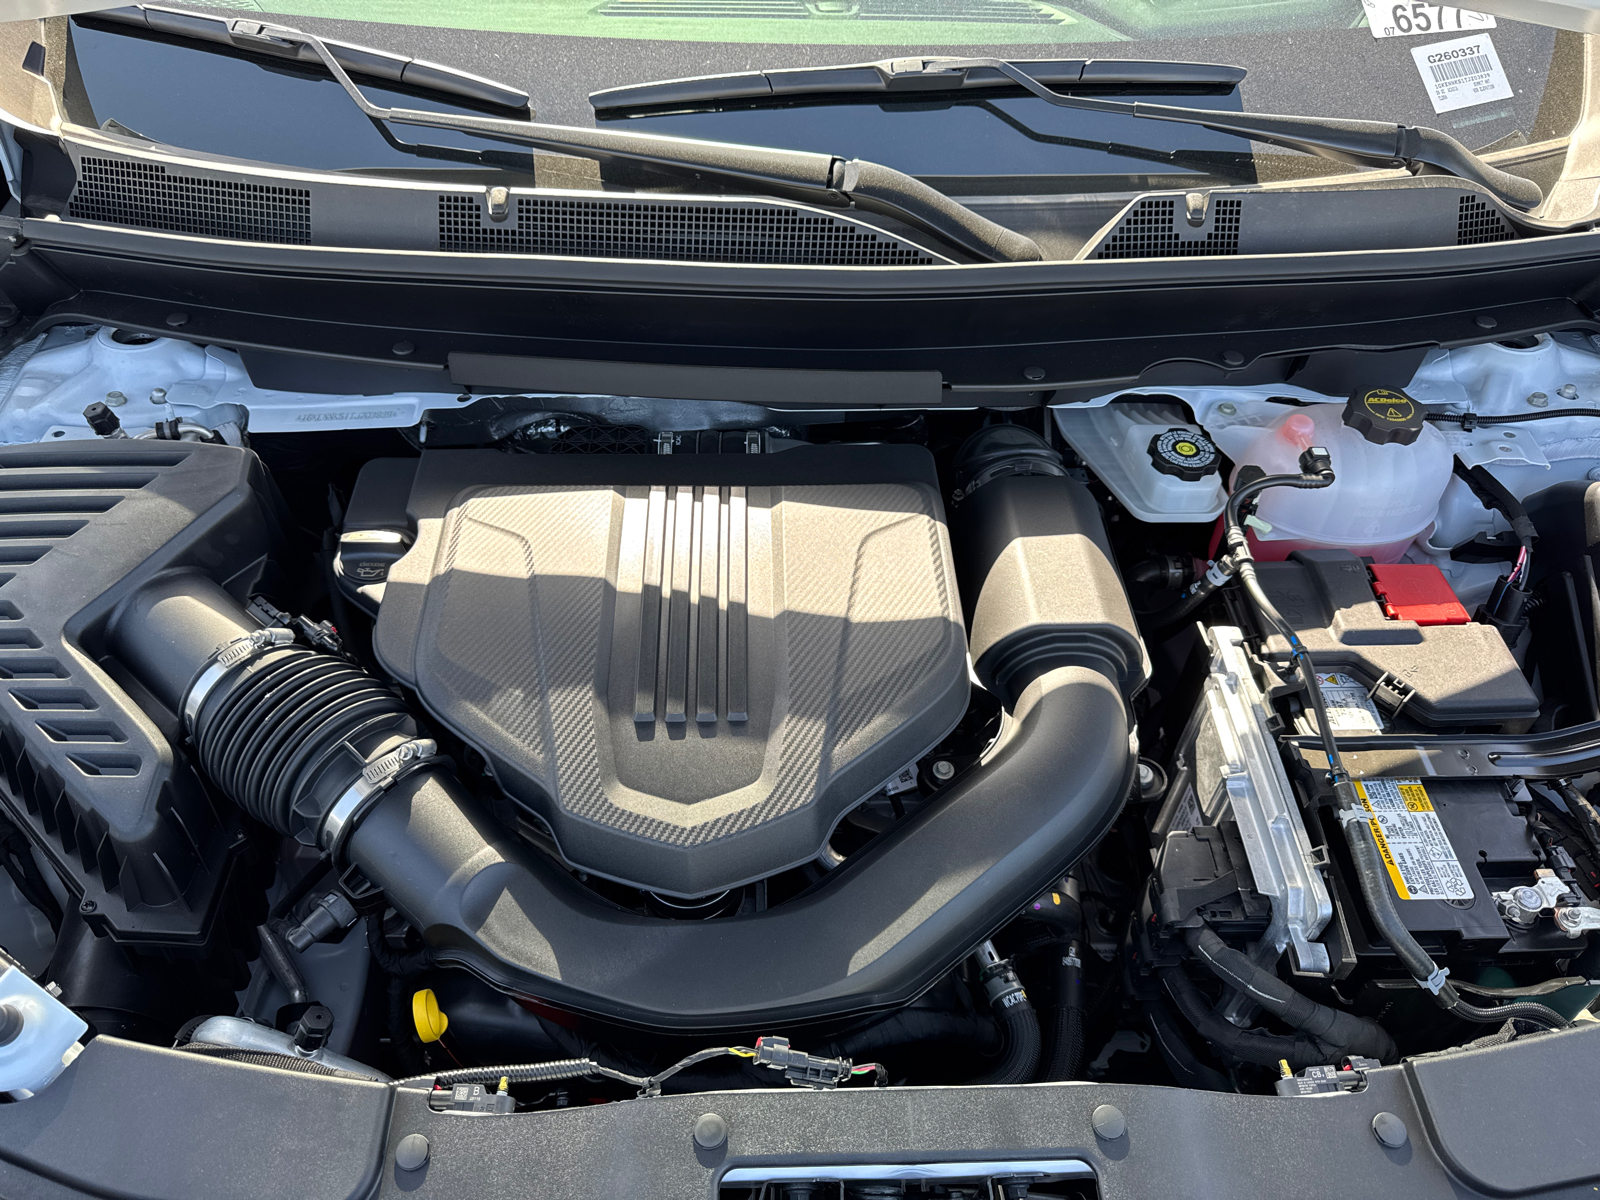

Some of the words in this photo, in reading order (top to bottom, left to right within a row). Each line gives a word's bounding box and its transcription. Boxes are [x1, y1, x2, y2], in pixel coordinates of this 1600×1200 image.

[1384, 26, 1396, 37] 07
[1427, 44, 1482, 64] G260337
[473, 1086, 480, 1096] B
